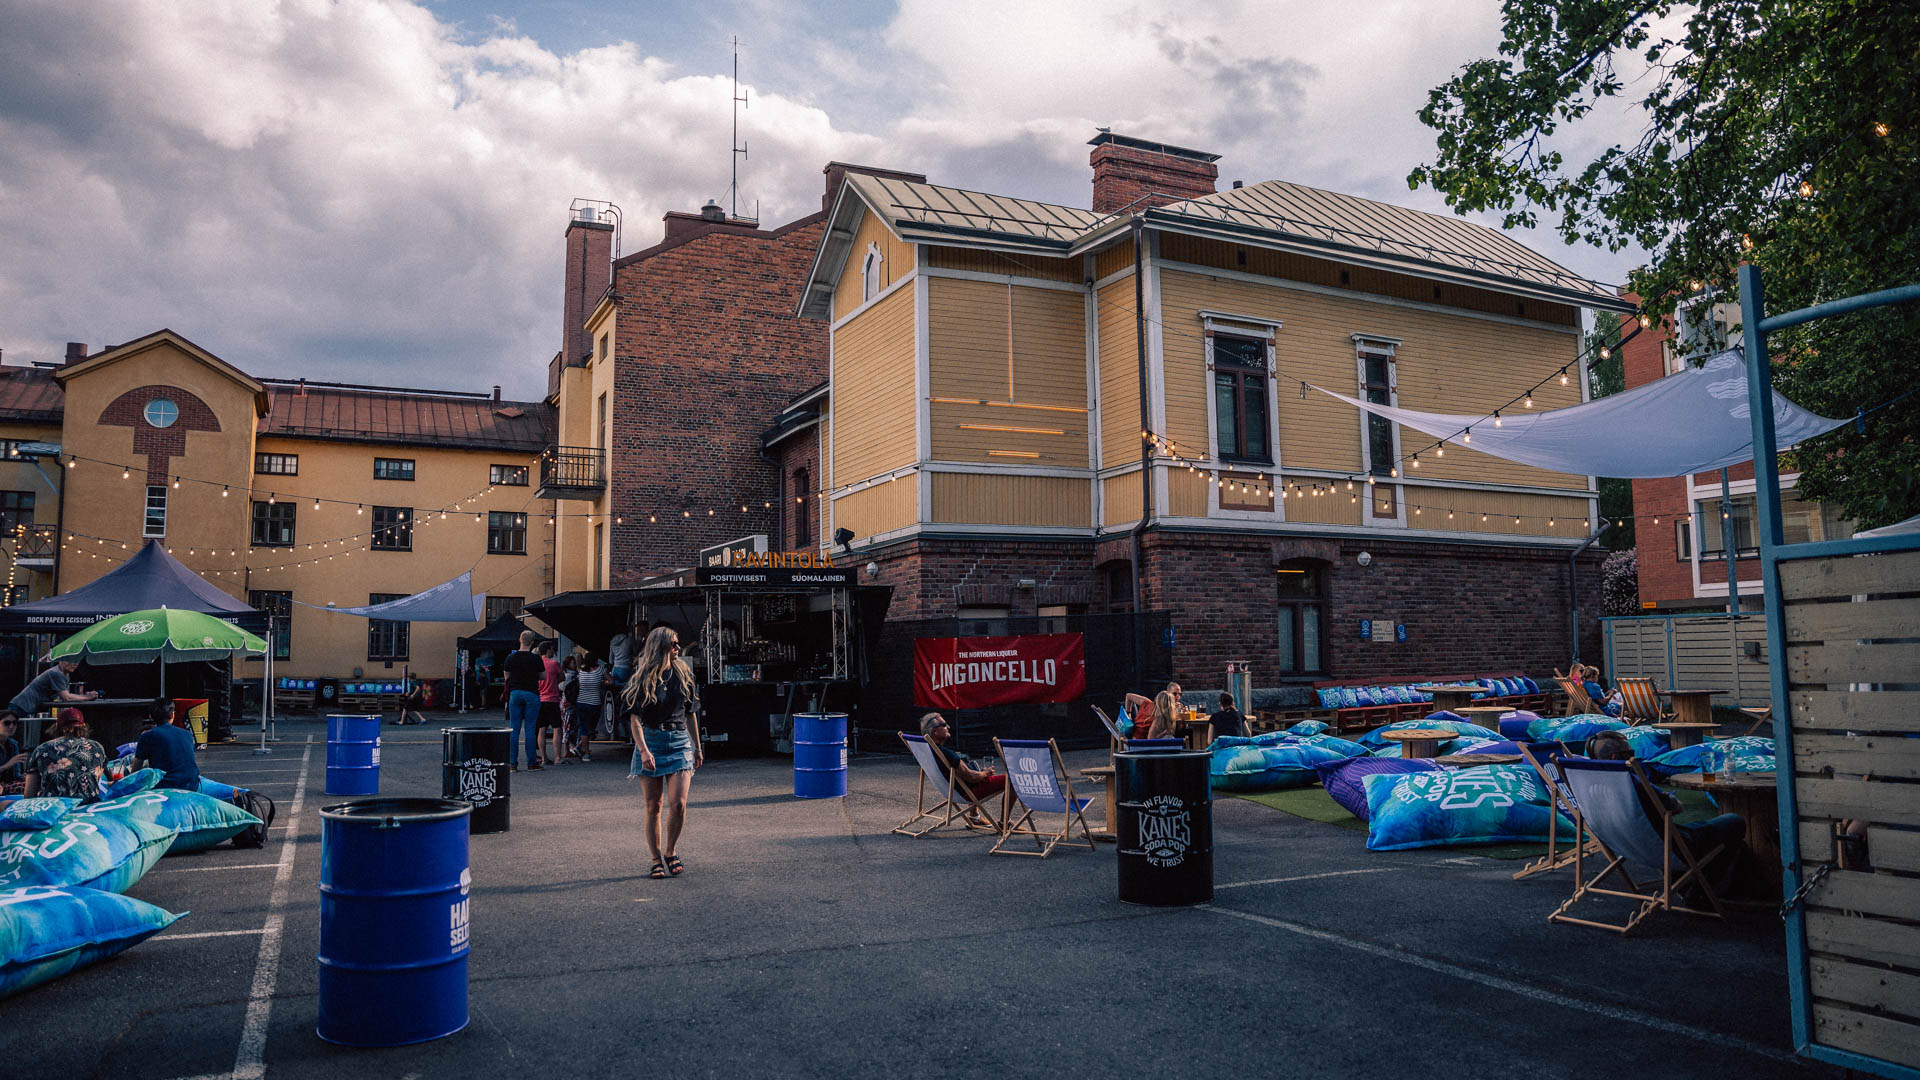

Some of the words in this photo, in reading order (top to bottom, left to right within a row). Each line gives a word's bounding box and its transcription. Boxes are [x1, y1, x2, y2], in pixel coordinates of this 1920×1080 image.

[732, 551, 835, 568] RAVINTOLA
[710, 574, 767, 582] POSITIIVISESTI
[791, 574, 846, 582] SUOMALAINEN
[968, 650, 996, 658] NORTHERN
[996, 649, 1018, 657] LIQUEUR
[931, 658, 1056, 691] LINGONCELLO
[463, 788, 479, 798] SODA
[1143, 799, 1153, 809] IN
[1153, 795, 1183, 809] FLAVOR
[1144, 839, 1167, 854] SODA
[1168, 840, 1186, 852] POP
[1146, 853, 1159, 866] WE
[1160, 854, 1184, 868] TRUST
